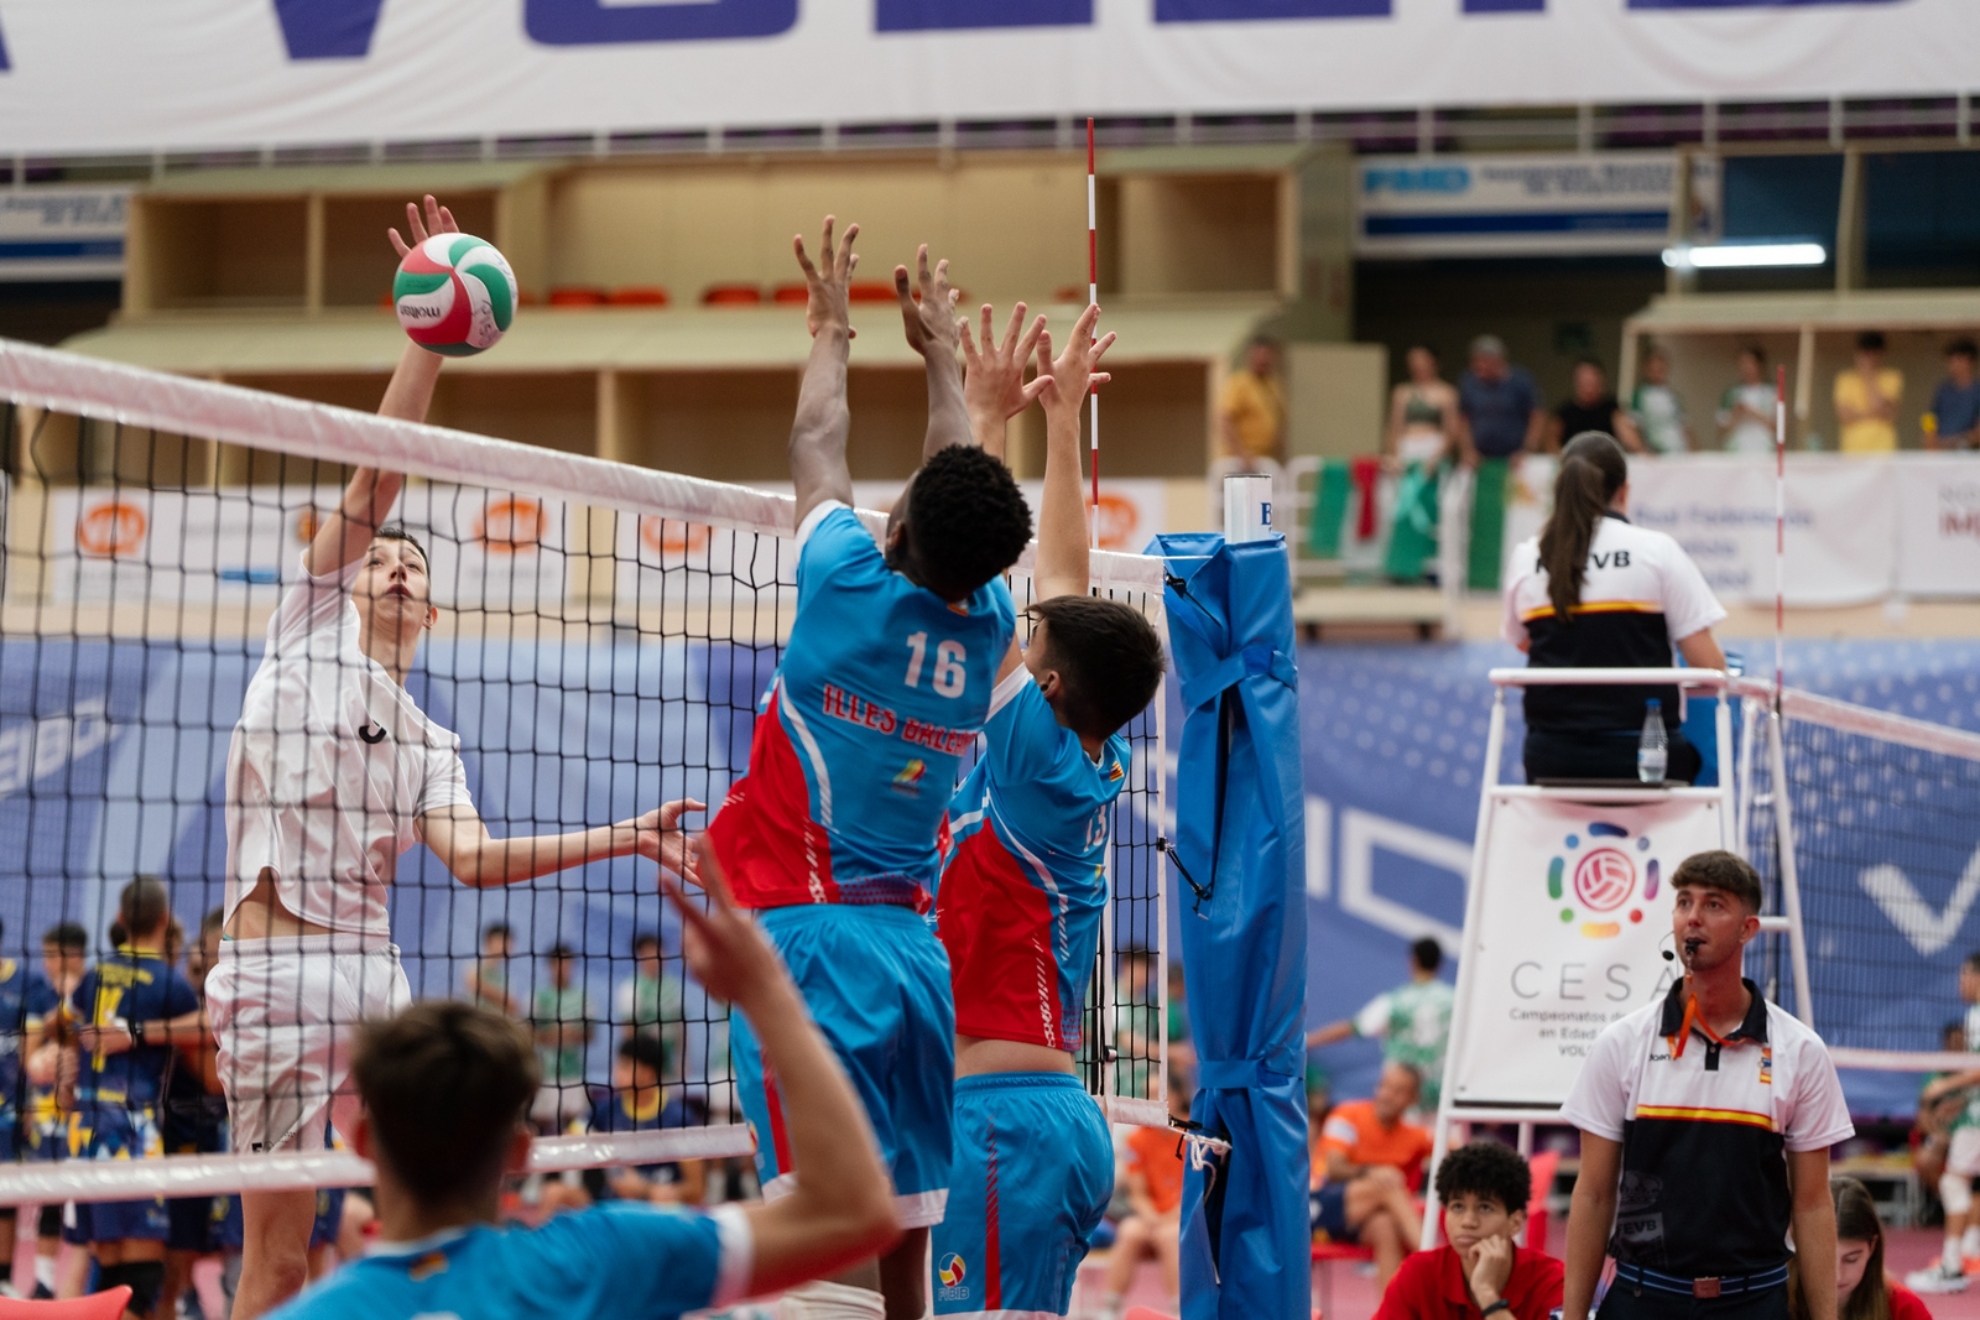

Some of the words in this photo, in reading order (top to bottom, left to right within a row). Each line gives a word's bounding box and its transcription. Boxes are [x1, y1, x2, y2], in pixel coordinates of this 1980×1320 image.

[904, 631, 967, 699] 16
[822, 682, 898, 736] ILLES
[1510, 961, 1677, 1002] CESA
[1508, 1007, 1607, 1022] Campeonatos
[1539, 1028, 1557, 1040] en
[1560, 1026, 1597, 1040] Edad
[1558, 1043, 1594, 1058] VOL
